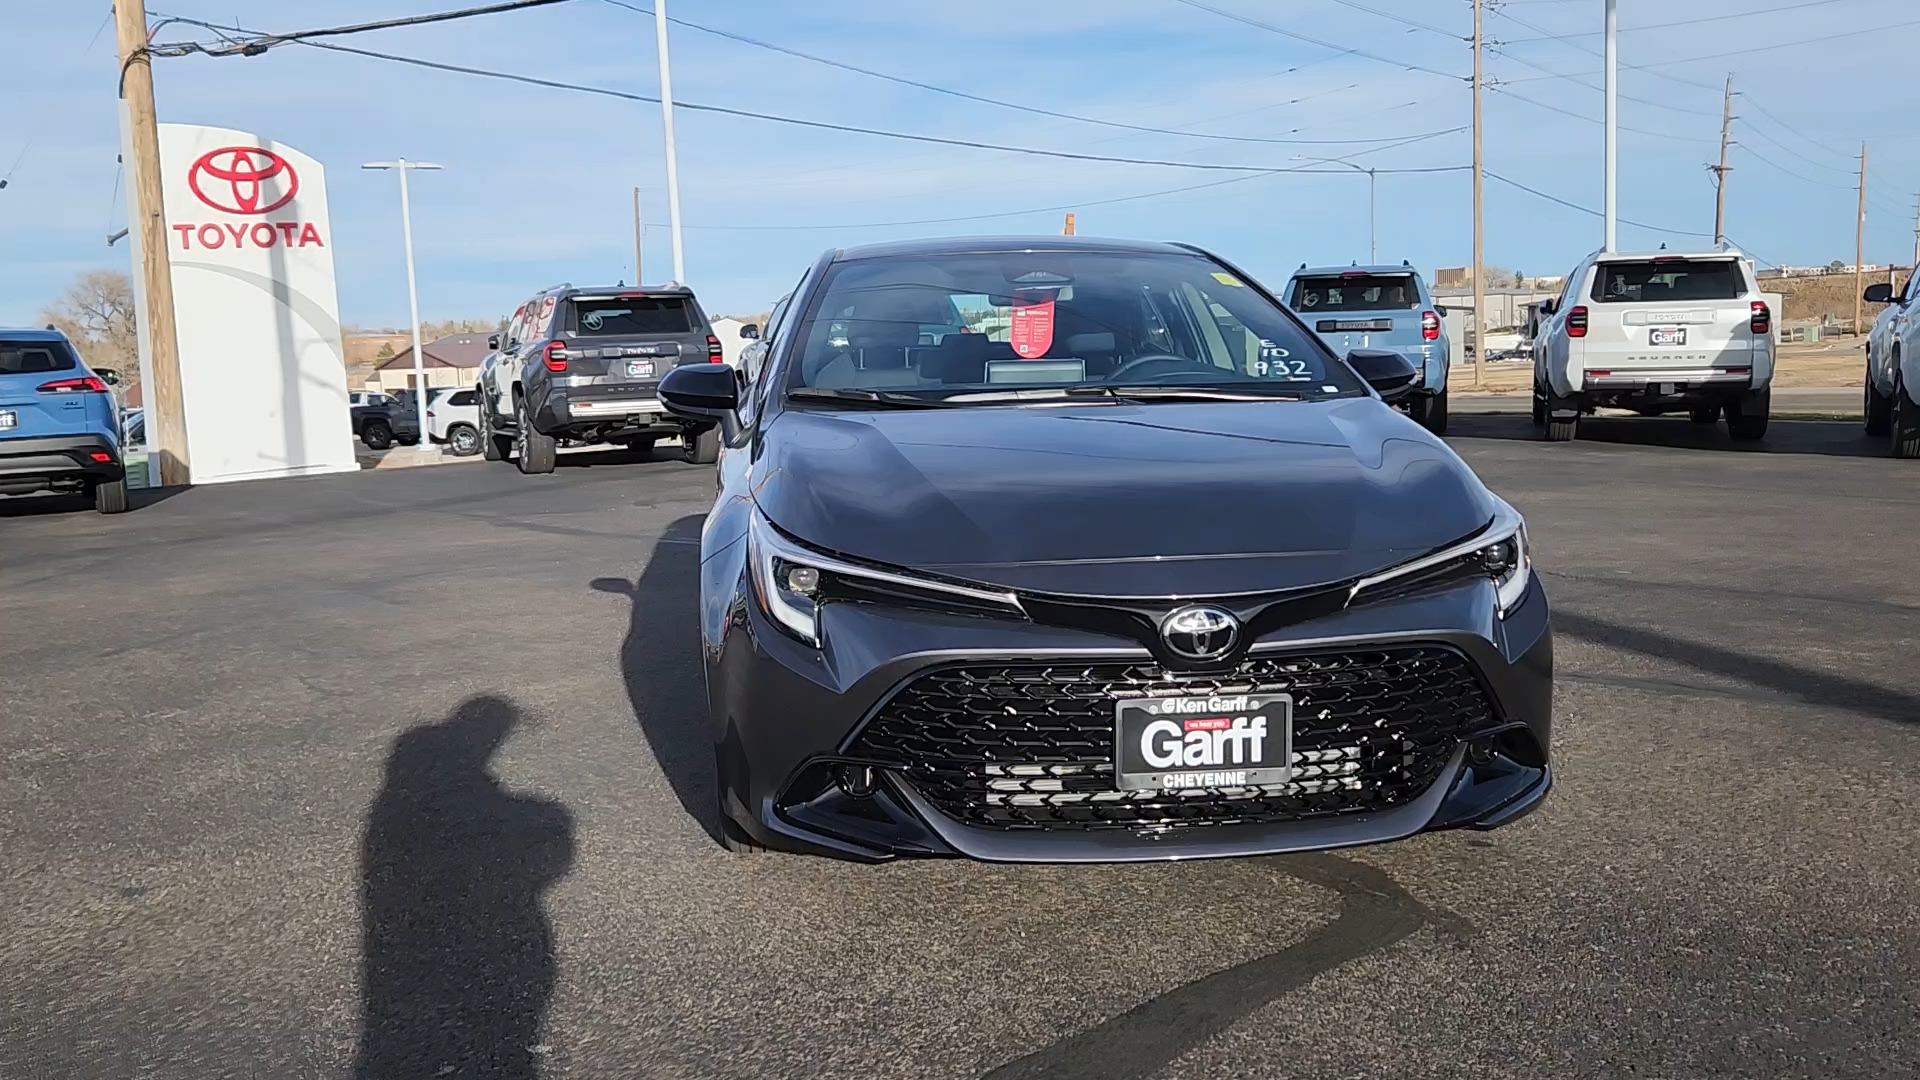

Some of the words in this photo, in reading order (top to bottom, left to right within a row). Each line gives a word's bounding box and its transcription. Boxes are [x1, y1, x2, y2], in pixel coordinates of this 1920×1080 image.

[172, 222, 325, 250] TOYOTA
[1651, 330, 1685, 343] Garff
[1254, 360, 1313, 375] 932
[1176, 698, 1207, 714] Ken
[1207, 696, 1249, 713] Garff
[1141, 716, 1268, 769] Garff
[1163, 771, 1247, 788] CHEYENNE
